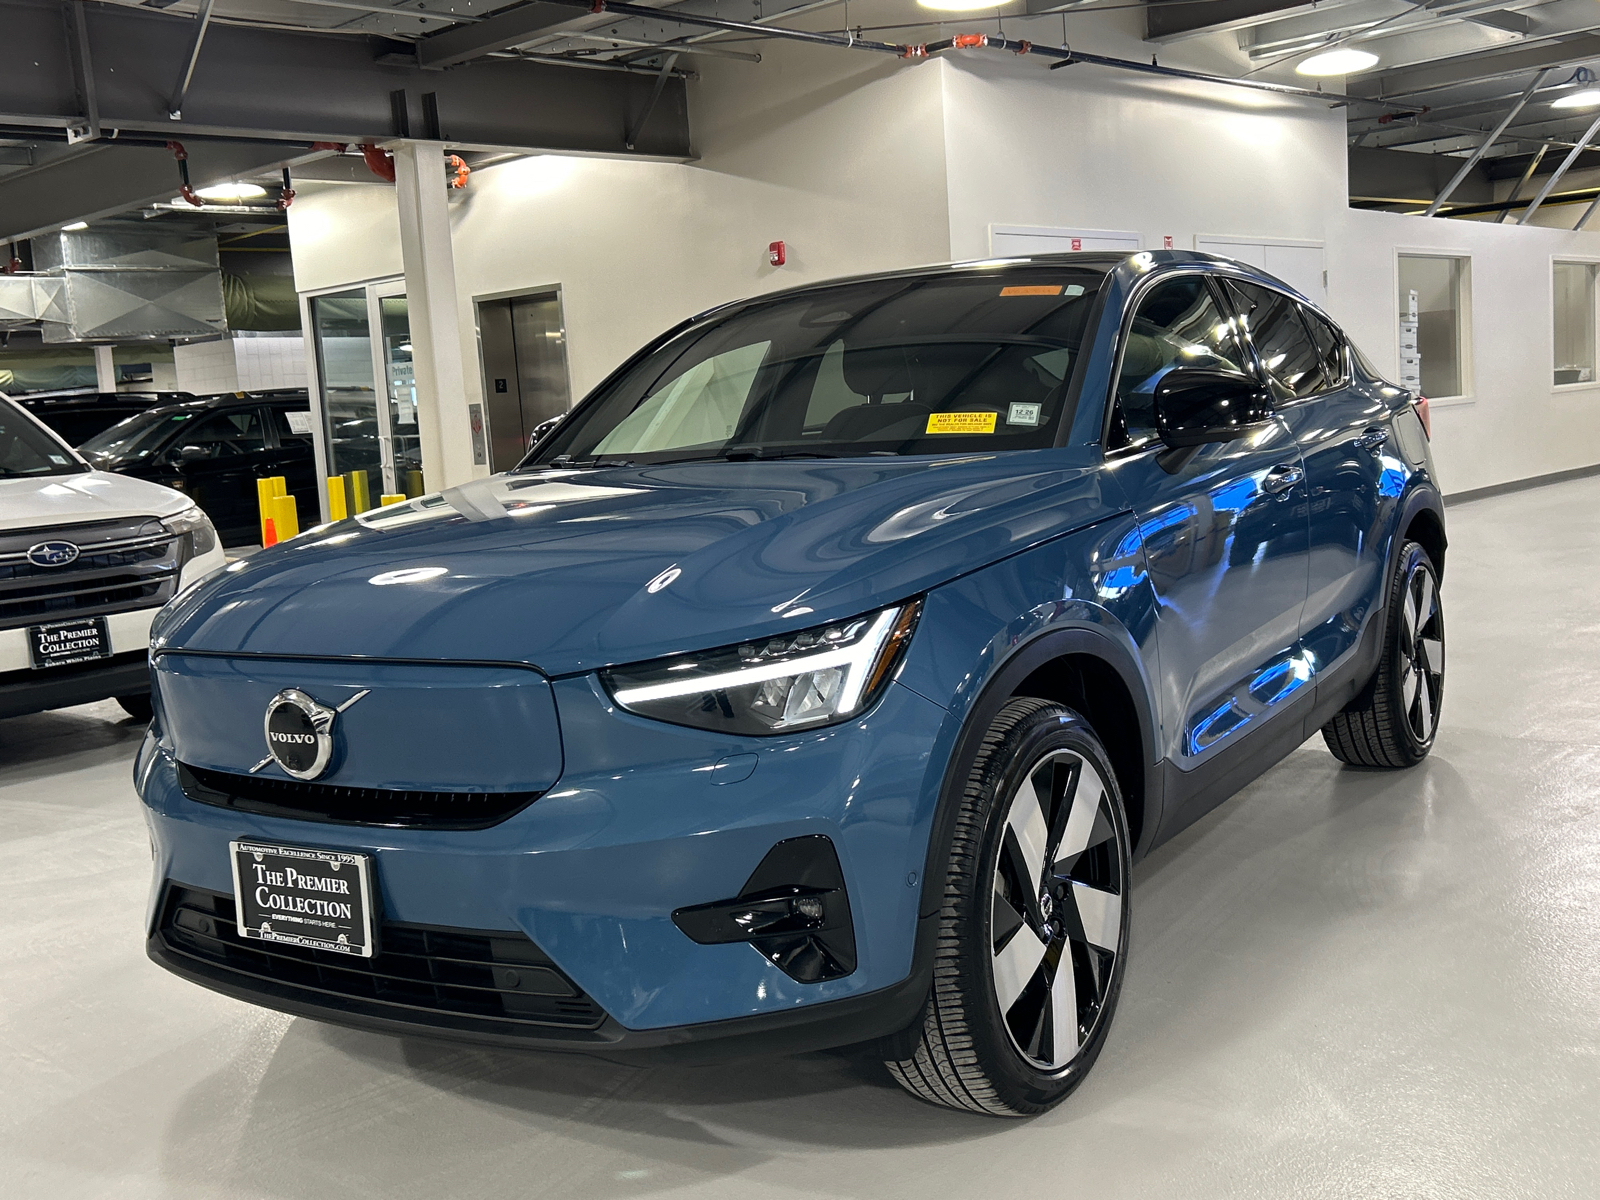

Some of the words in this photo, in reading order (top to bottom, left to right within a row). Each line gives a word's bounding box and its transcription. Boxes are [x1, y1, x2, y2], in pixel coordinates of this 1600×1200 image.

[270, 732, 315, 744] VOLVO
[252, 864, 284, 886] THE
[285, 867, 350, 894] PREMIER
[256, 886, 352, 919] COLLECTION
[272, 913, 304, 924] EVERYTHING
